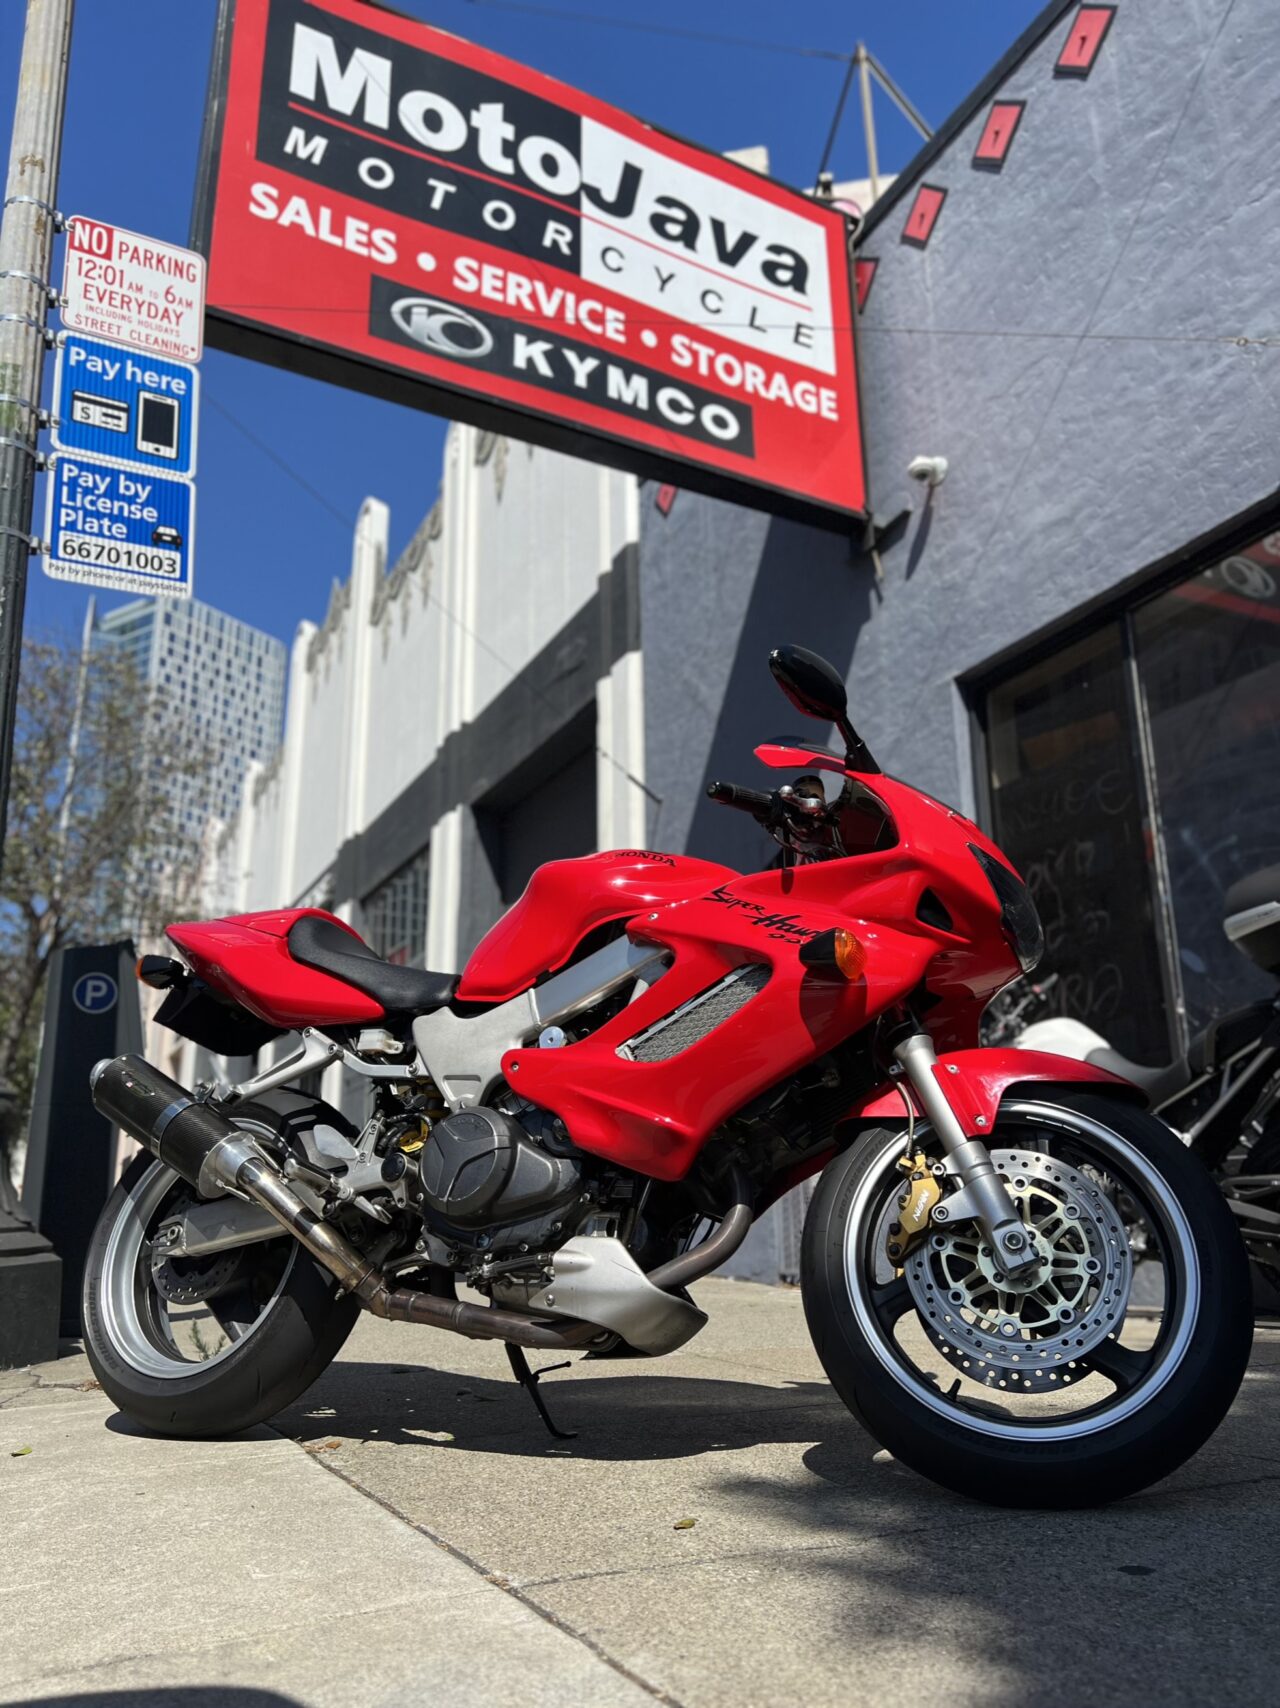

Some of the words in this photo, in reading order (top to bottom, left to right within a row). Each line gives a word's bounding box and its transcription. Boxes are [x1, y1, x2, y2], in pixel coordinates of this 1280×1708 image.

[74, 220, 108, 256] NO
[118, 240, 197, 283] PARKING
[83, 283, 184, 327] EVERYDAY
[86, 303, 133, 324] INCLUDING
[137, 319, 180, 338] HOLIDAYS
[249, 182, 397, 264] SALES
[452, 256, 627, 344] SERVICE
[670, 333, 839, 422] STORAGE
[75, 313, 121, 337] STREET
[129, 329, 190, 356] CLEANING
[69, 345, 121, 381] Pay
[126, 359, 187, 395] here
[513, 333, 740, 441] KYMCO
[62, 462, 111, 494] Pay
[119, 473, 152, 503] by
[60, 507, 127, 538] Plate
[61, 485, 158, 523] License
[48, 562, 66, 574] Pay
[68, 565, 80, 577] by
[83, 568, 113, 581] phone
[115, 574, 126, 582] or
[127, 576, 137, 585] at
[62, 538, 177, 574] 66701003
[615, 851, 676, 868] HONDA
[85, 980, 108, 1007] P
